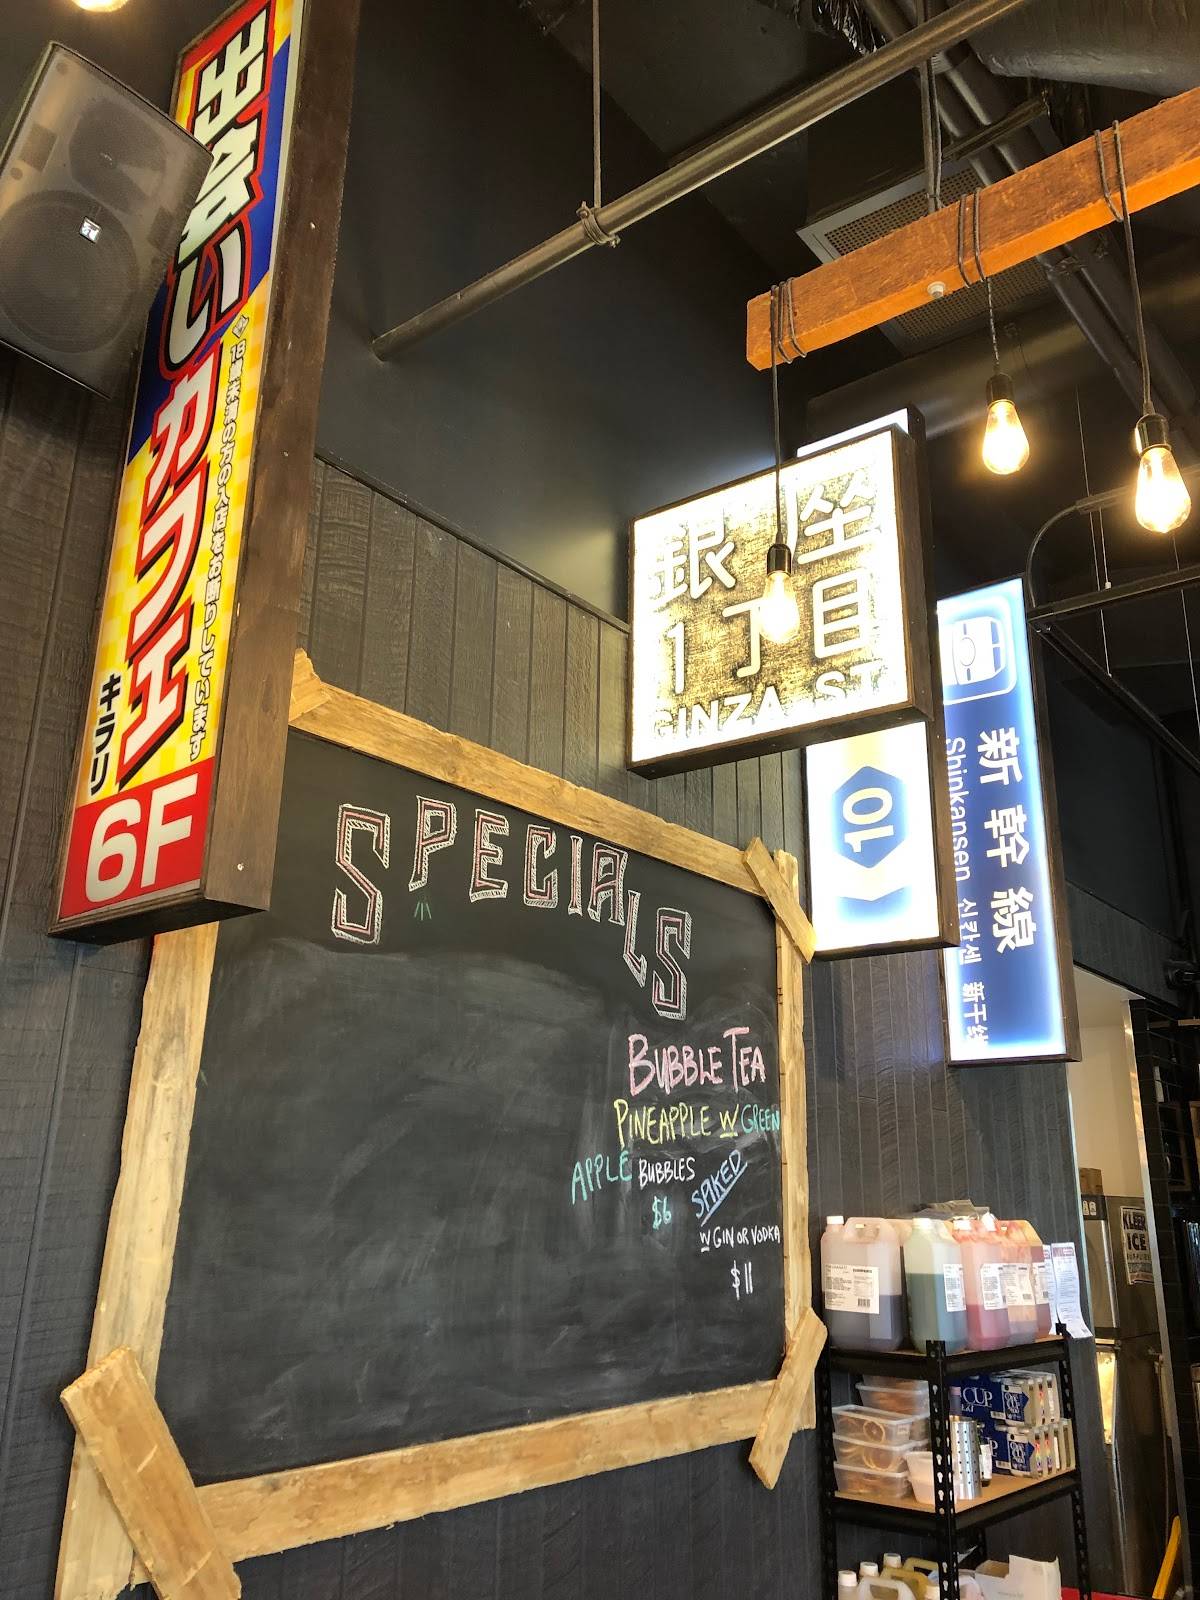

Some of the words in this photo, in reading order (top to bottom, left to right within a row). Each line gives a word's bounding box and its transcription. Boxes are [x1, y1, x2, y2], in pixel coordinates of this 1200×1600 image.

[647, 468, 884, 612] 銀座
[665, 566, 873, 696] 1丁目
[90, 671, 122, 796] キラリ
[653, 684, 788, 742] GINZA
[85, 773, 199, 903] 6F
[945, 736, 971, 882] Shinkansen
[977, 727, 1037, 954] 新幹線
[332, 795, 692, 1020] SPECIALS
[628, 1033, 723, 1096] BUBBLE
[724, 1026, 766, 1092] TEA
[614, 1099, 711, 1148] PINEAPPLE
[741, 1103, 780, 1133] GREEN
[571, 1150, 633, 1205] APPLE
[639, 1157, 695, 1188] BUBBLES
[651, 1195, 672, 1230] $6
[713, 1226, 734, 1248] GIN
[750, 1225, 781, 1245] VODKA
[1127, 1233, 1147, 1251] ICE
[730, 1260, 754, 1300] $11
